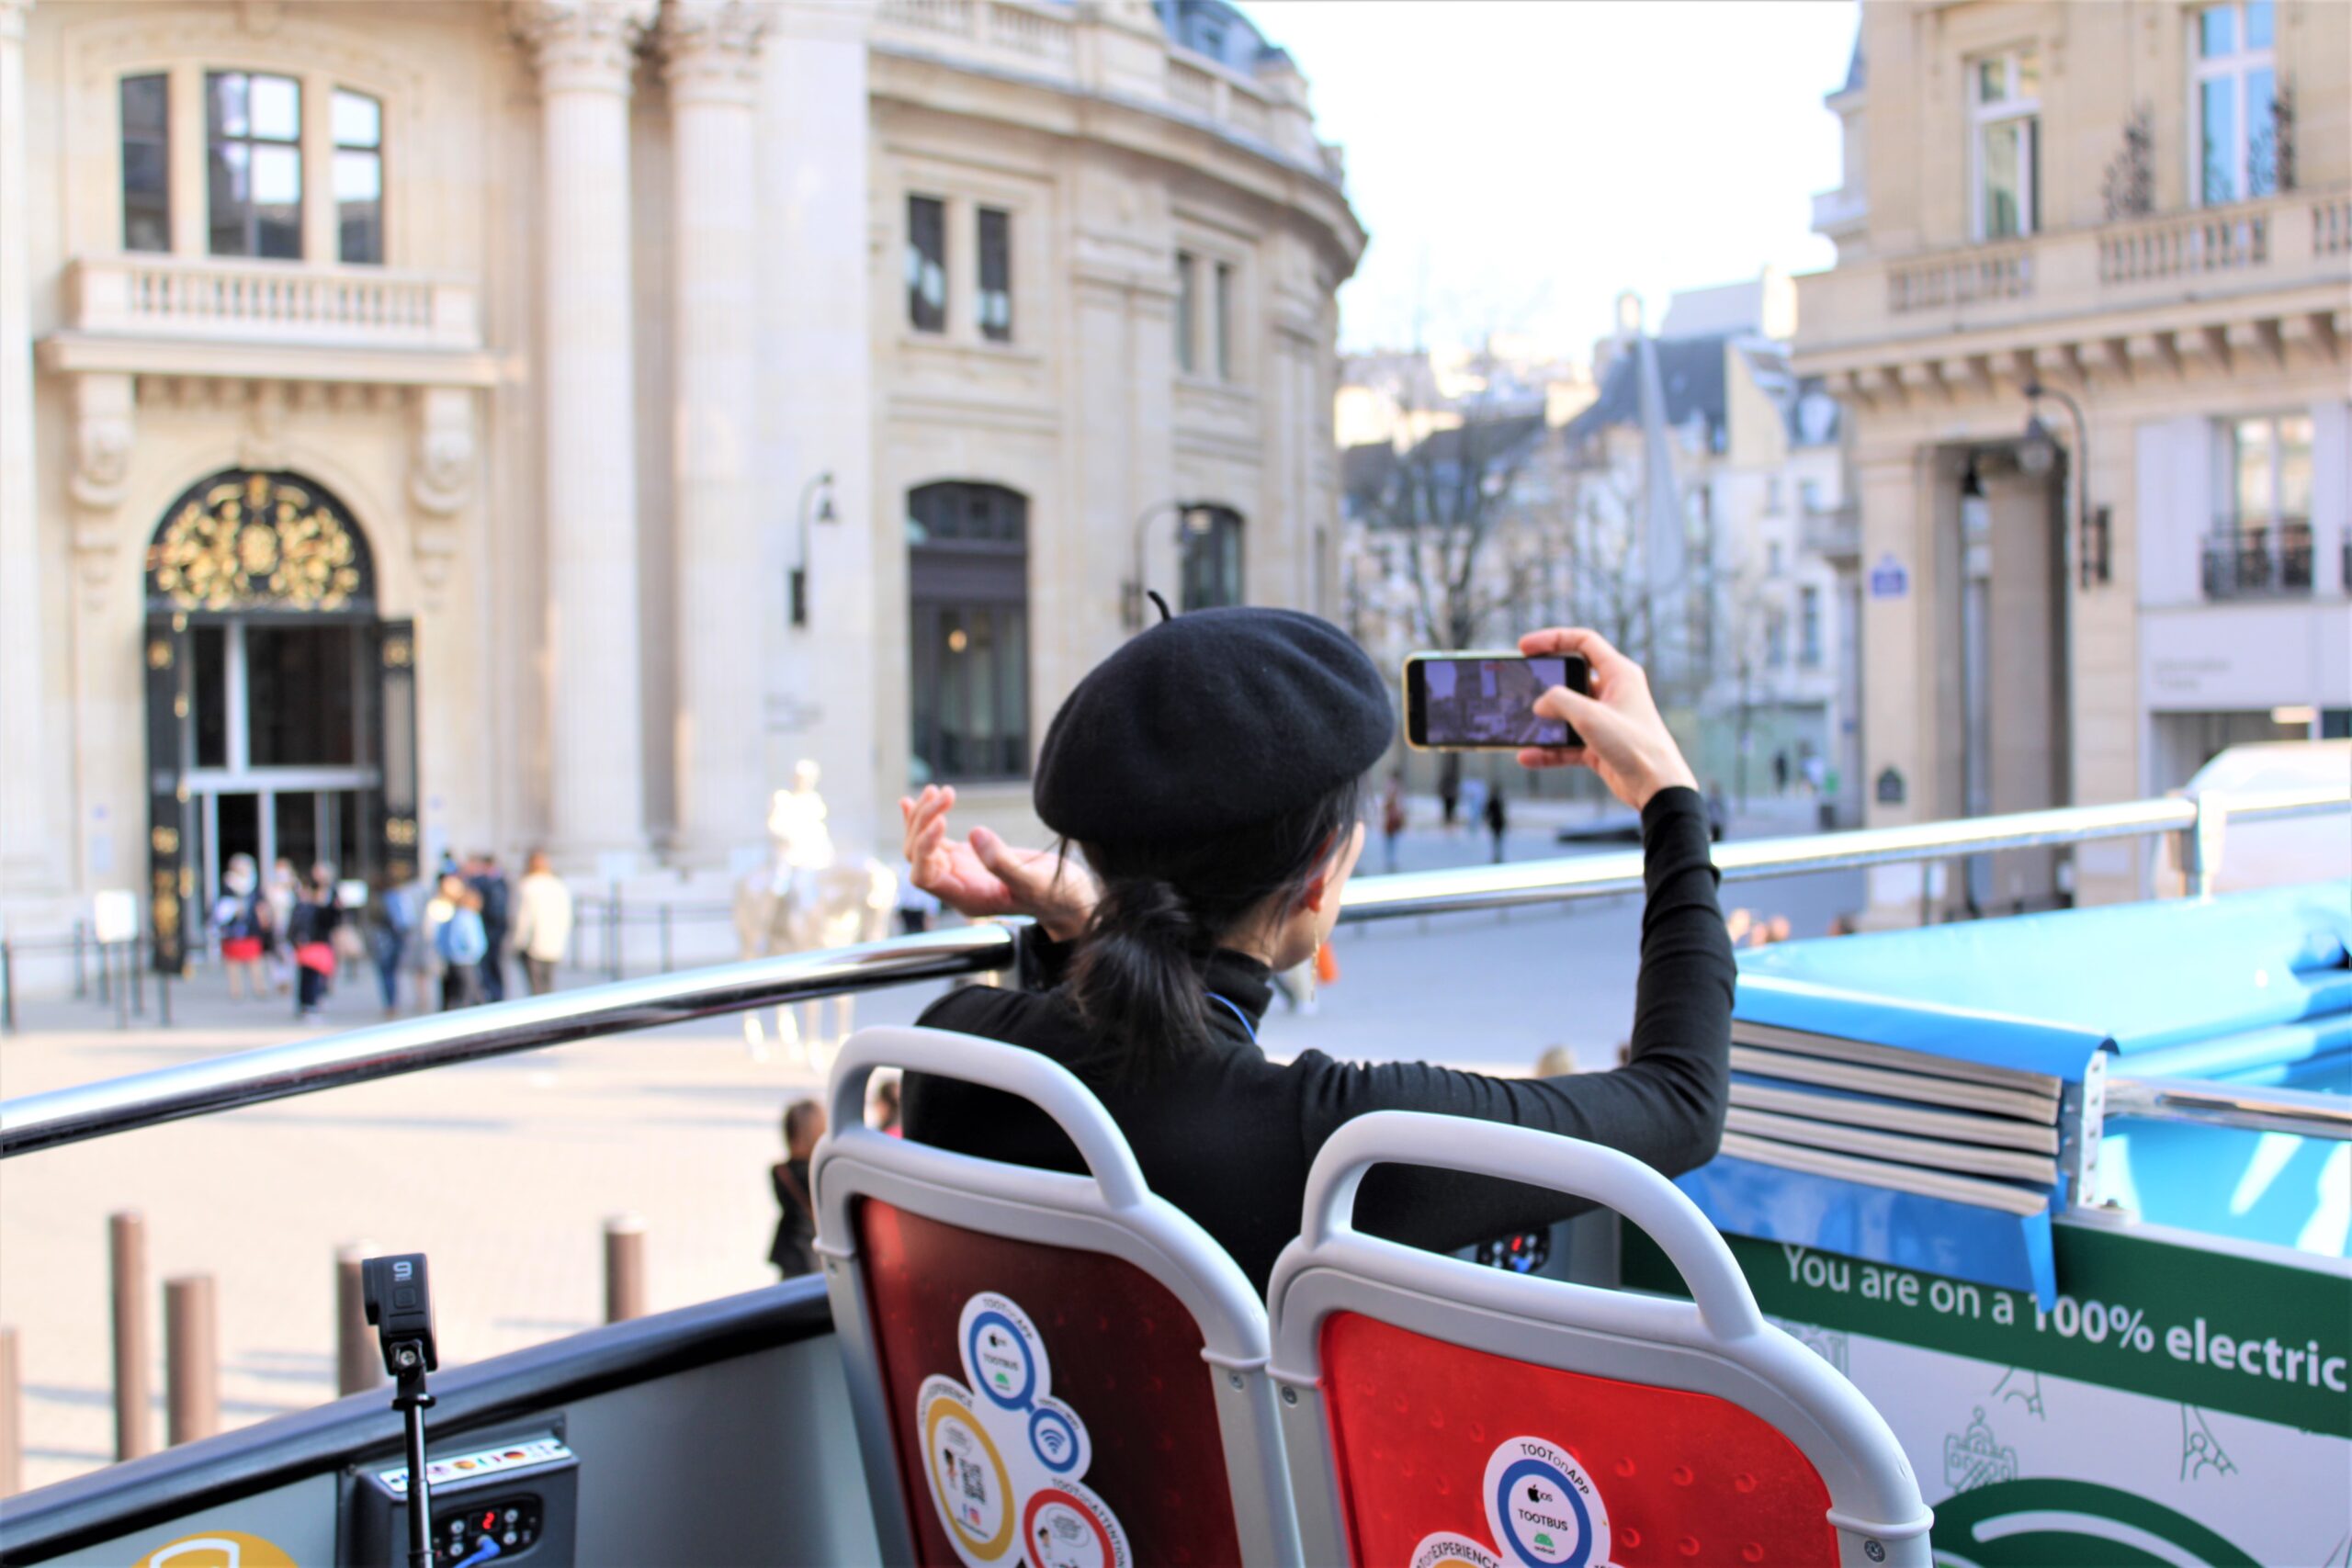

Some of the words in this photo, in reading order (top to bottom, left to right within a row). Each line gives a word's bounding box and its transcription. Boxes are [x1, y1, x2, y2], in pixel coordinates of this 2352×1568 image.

[393, 1261, 413, 1278] 9
[1781, 1243, 1850, 1293] You
[1860, 1267, 1920, 1307] are
[1929, 1280, 1981, 1319] on
[1992, 1292, 2015, 1325] a
[2029, 1293, 2155, 1353] 100%
[2165, 1317, 2347, 1393] electric
[1518, 1508, 1569, 1532] TOOTBUS
